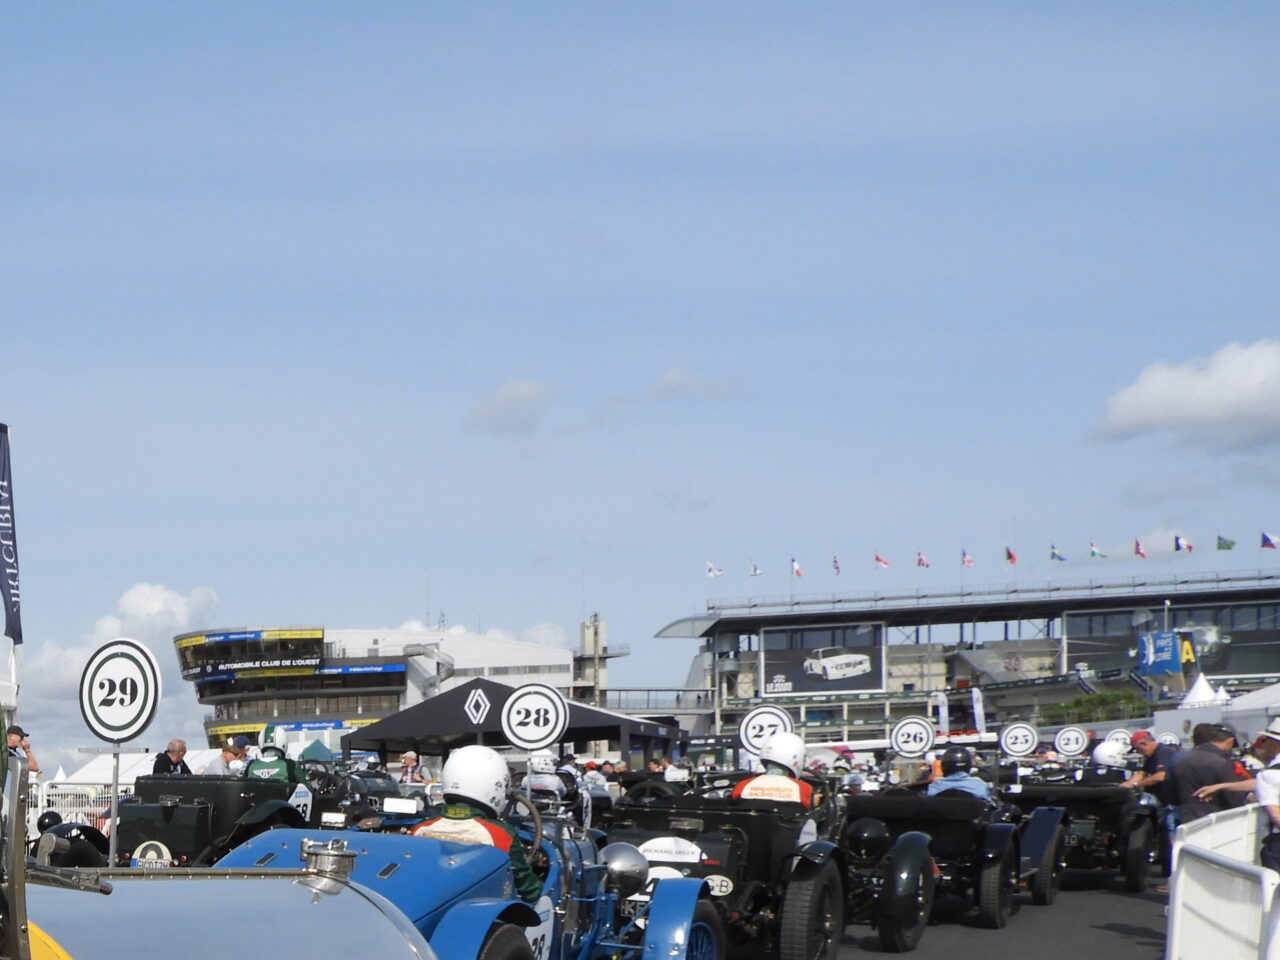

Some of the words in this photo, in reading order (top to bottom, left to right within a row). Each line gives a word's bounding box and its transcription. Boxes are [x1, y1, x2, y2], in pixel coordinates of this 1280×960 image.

[218, 661, 260, 670] AUTOMOBILE
[98, 676, 139, 708] 29
[515, 707, 551, 728] 28
[752, 723, 780, 739] 27
[901, 731, 924, 744] 26
[1009, 734, 1029, 746] 25
